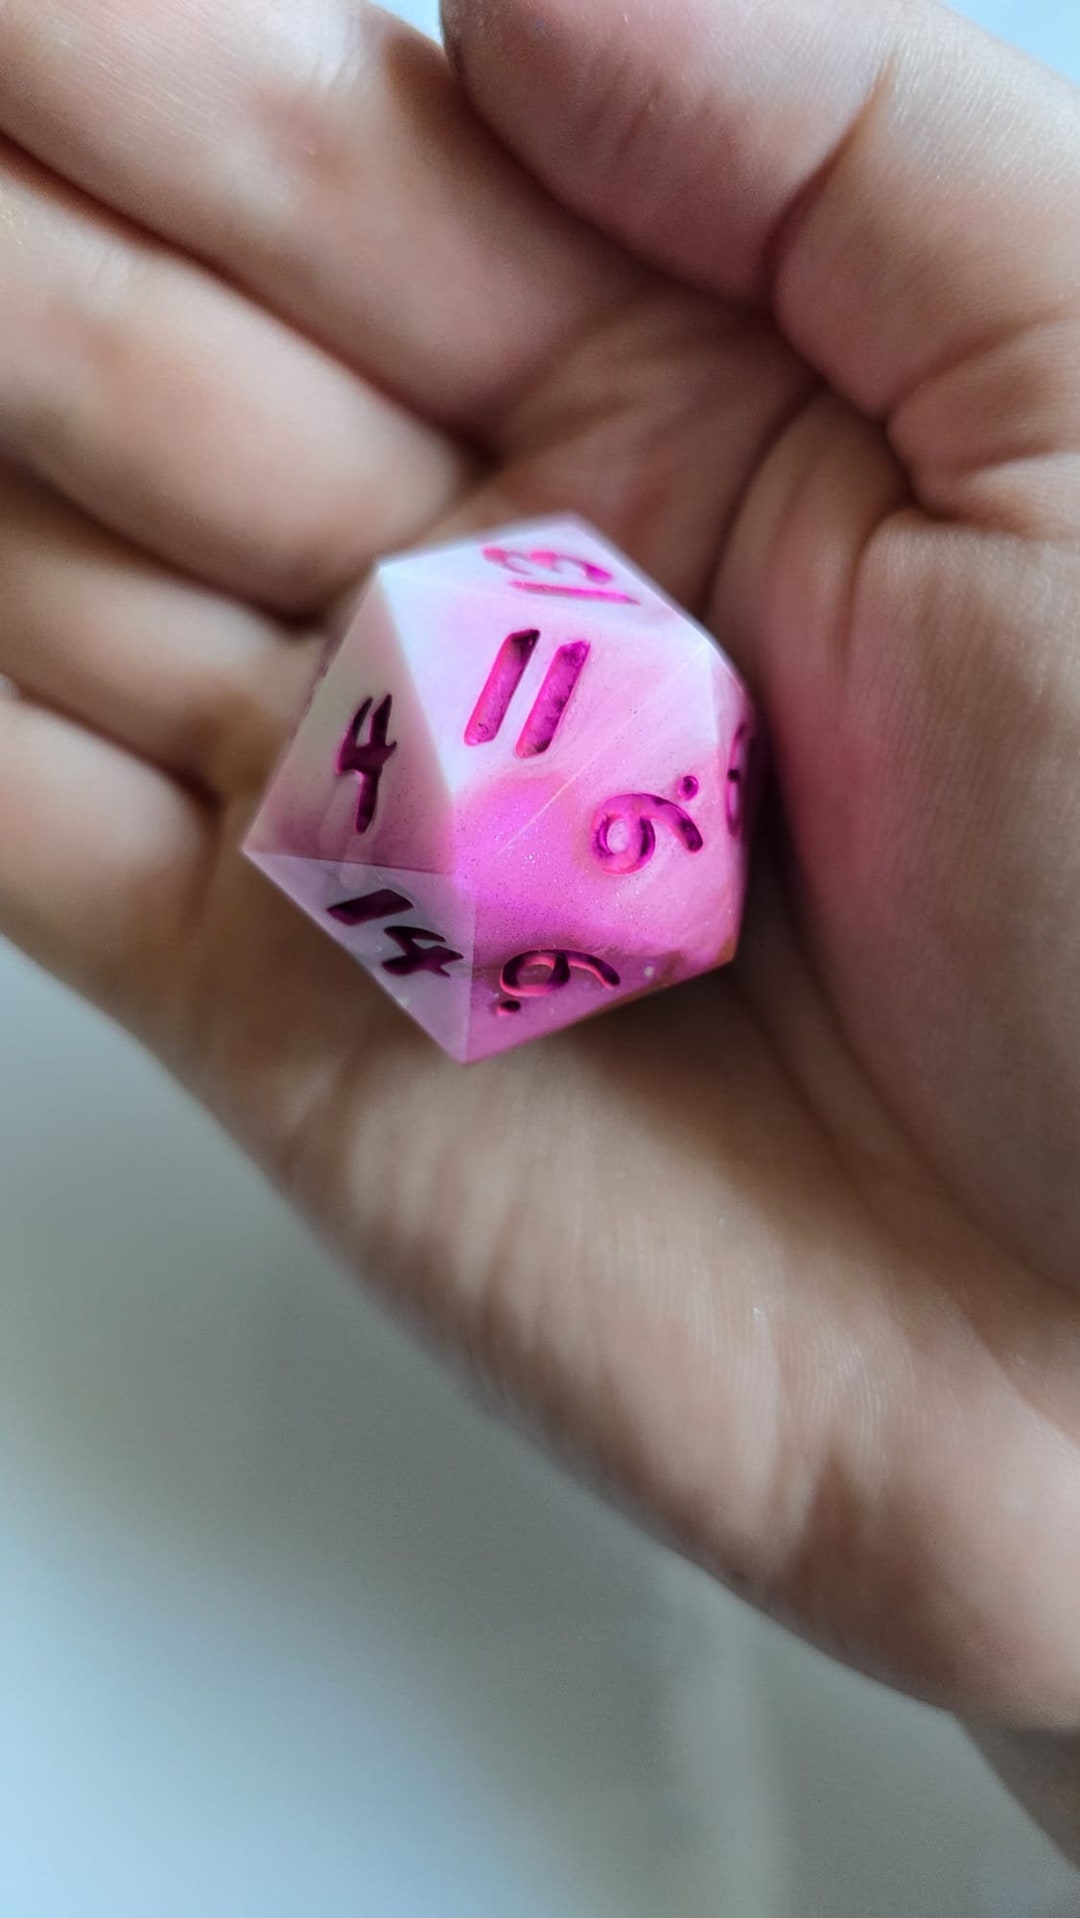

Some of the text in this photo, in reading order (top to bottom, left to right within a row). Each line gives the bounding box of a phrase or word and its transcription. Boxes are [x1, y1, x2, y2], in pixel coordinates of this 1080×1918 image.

[482, 547, 641, 605] 13
[464, 629, 591, 758] 11
[335, 694, 397, 834] 4
[326, 888, 463, 977] 14
